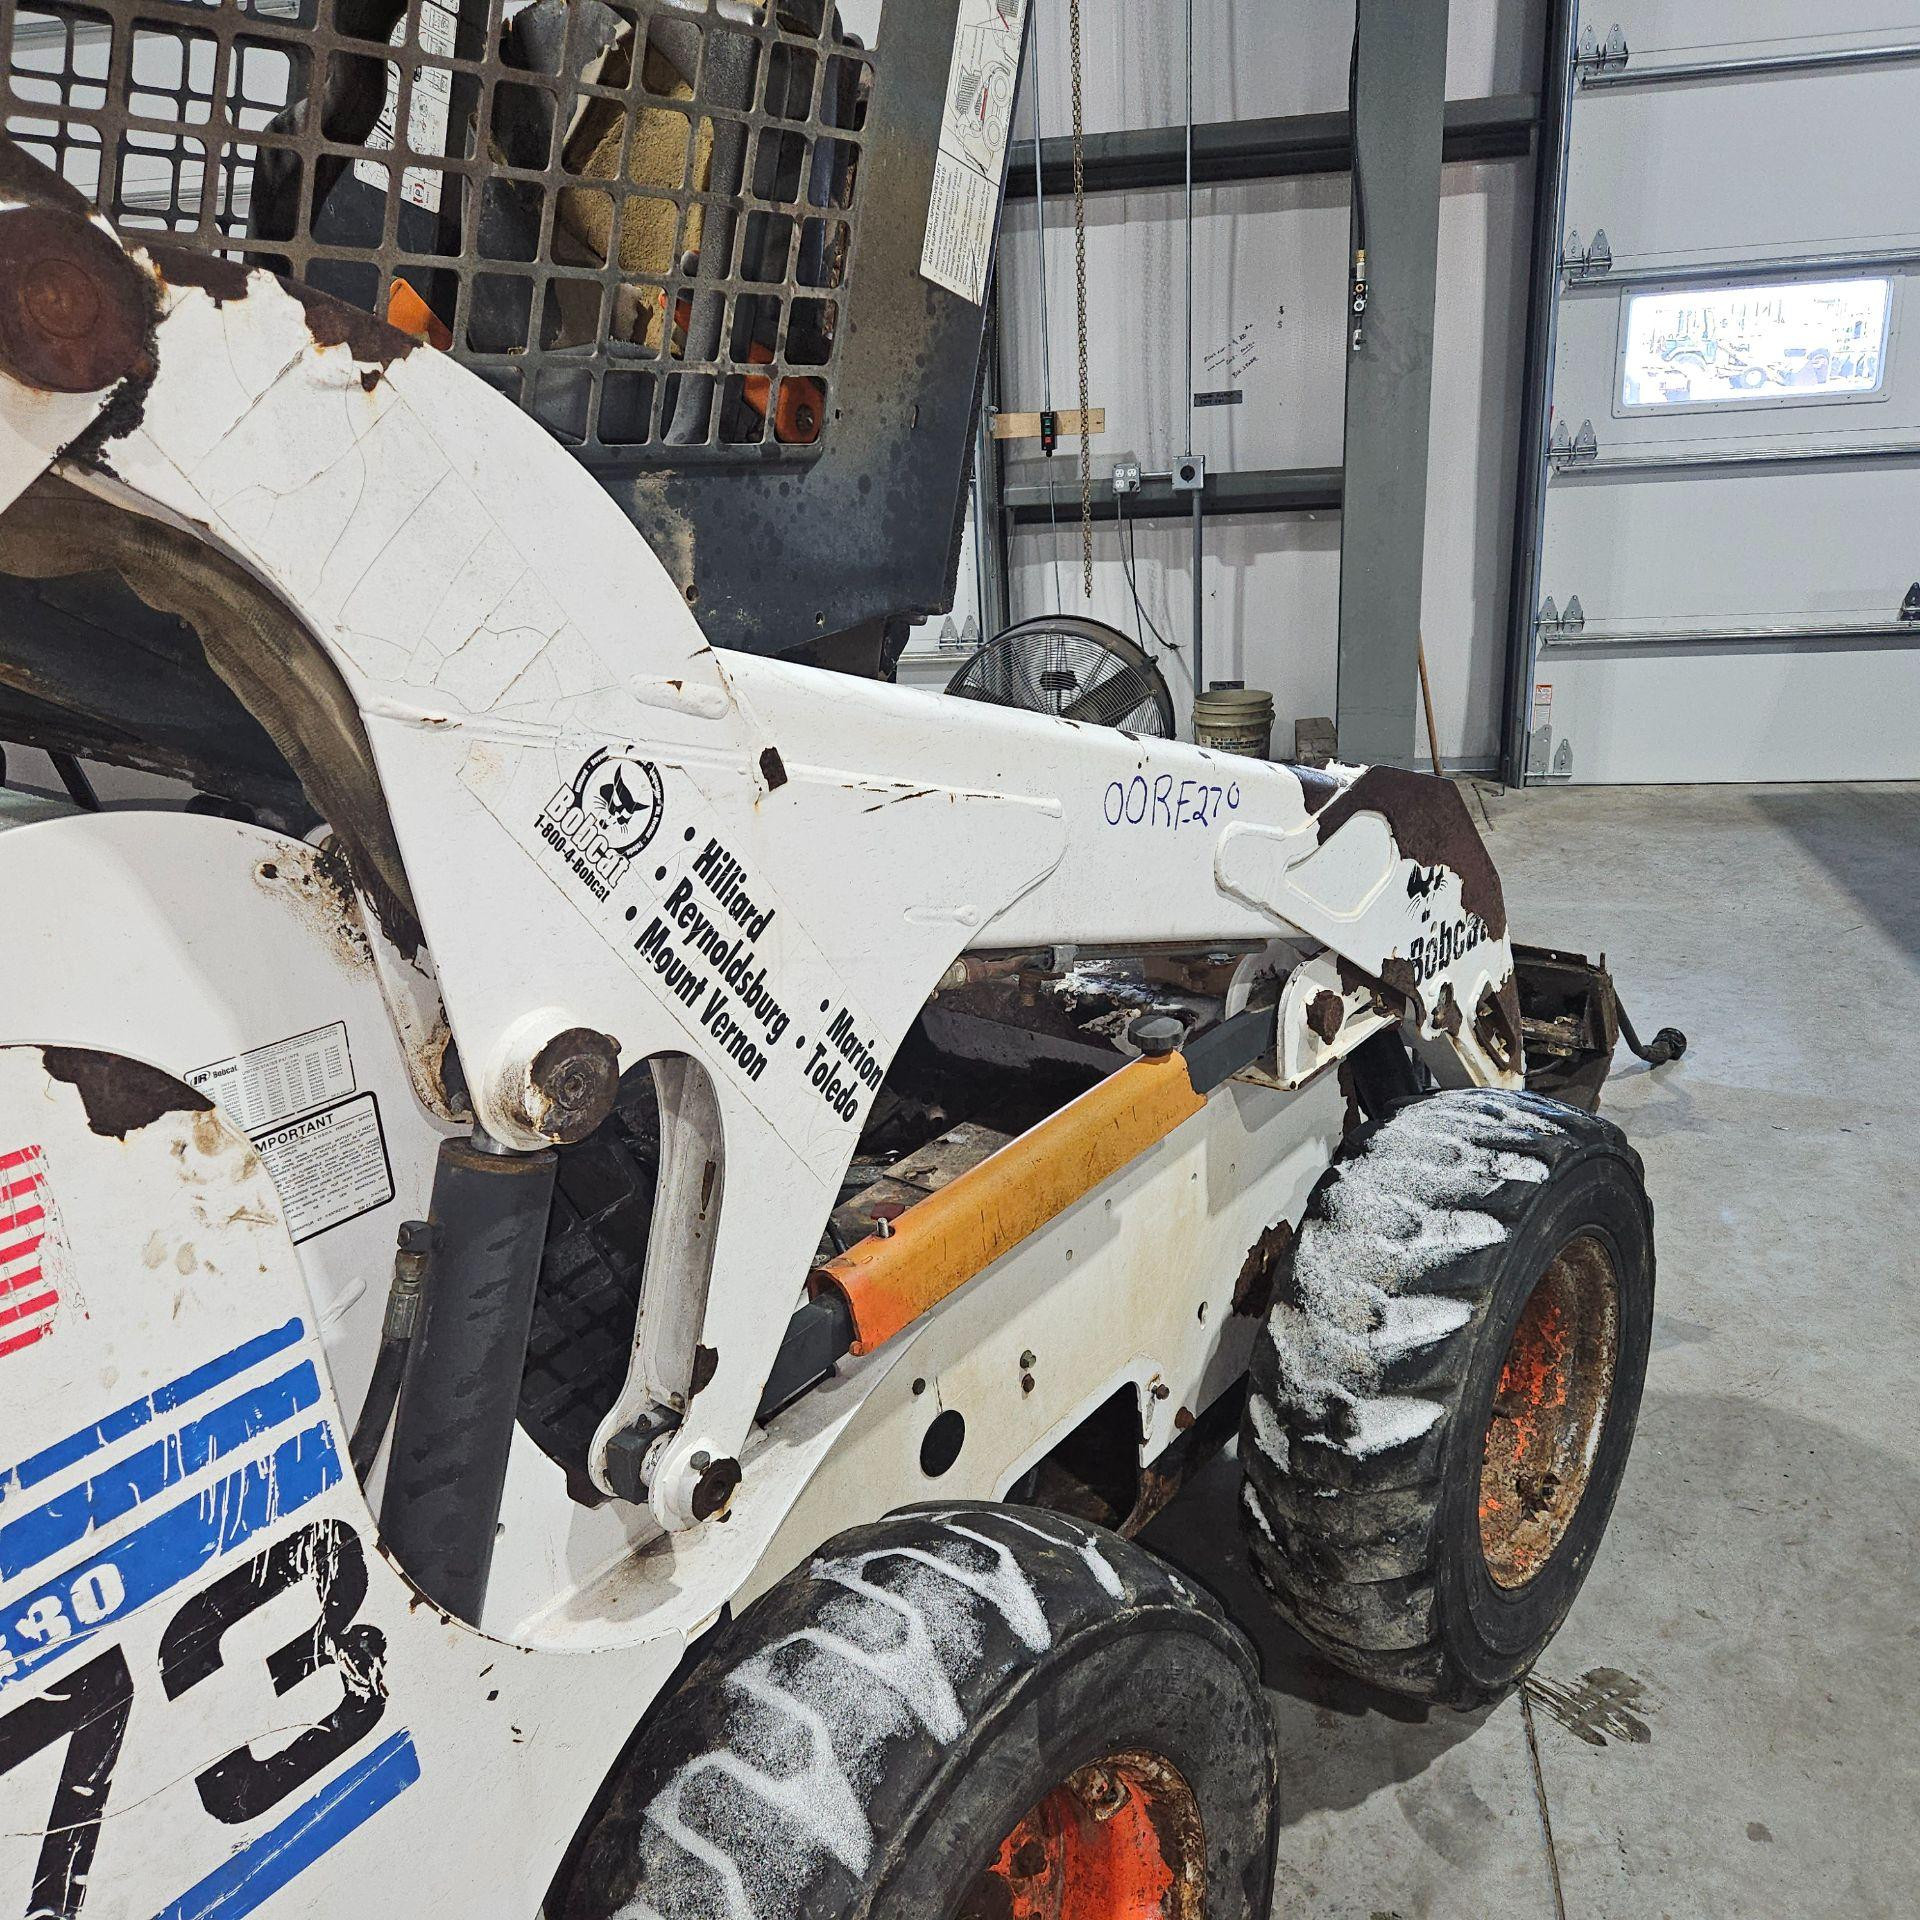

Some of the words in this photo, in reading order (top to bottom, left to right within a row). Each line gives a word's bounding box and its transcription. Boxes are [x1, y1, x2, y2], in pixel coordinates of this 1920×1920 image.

[924, 220, 932, 251] INSTALL
[928, 178, 939, 219] APPROVED
[930, 212, 940, 246] SUPPORT
[533, 815, 610, 903] 1-800-4-Bobcat
[544, 782, 632, 889] Bobcat
[691, 837, 776, 943] Hilliard
[633, 916, 707, 1007] Mount
[700, 987, 768, 1082] Vernon
[663, 876, 791, 1046] Reynoldsburg
[212, 1064, 239, 1079] Bobcat
[803, 1042, 859, 1122] Toledo
[825, 1007, 884, 1092] Marion
